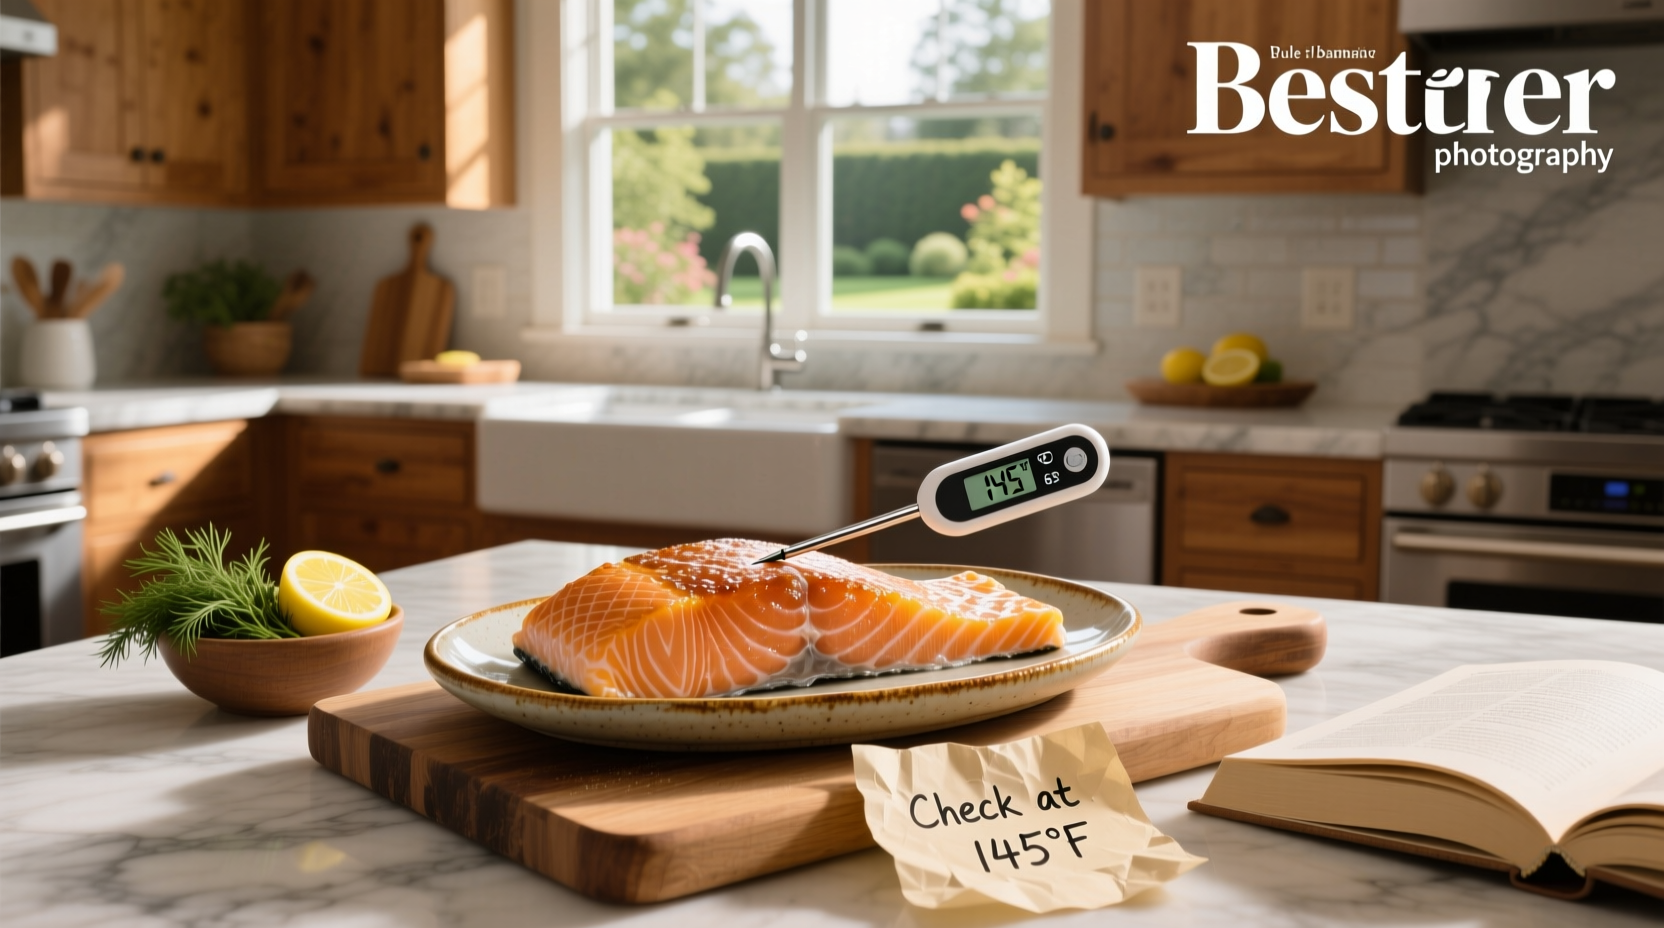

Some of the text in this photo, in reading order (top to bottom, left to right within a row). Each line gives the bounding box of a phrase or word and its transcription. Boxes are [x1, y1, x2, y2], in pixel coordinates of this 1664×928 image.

[984, 465, 1025, 501] 145
[910, 777, 1080, 829] Check at
[974, 821, 1088, 873] 145°F
